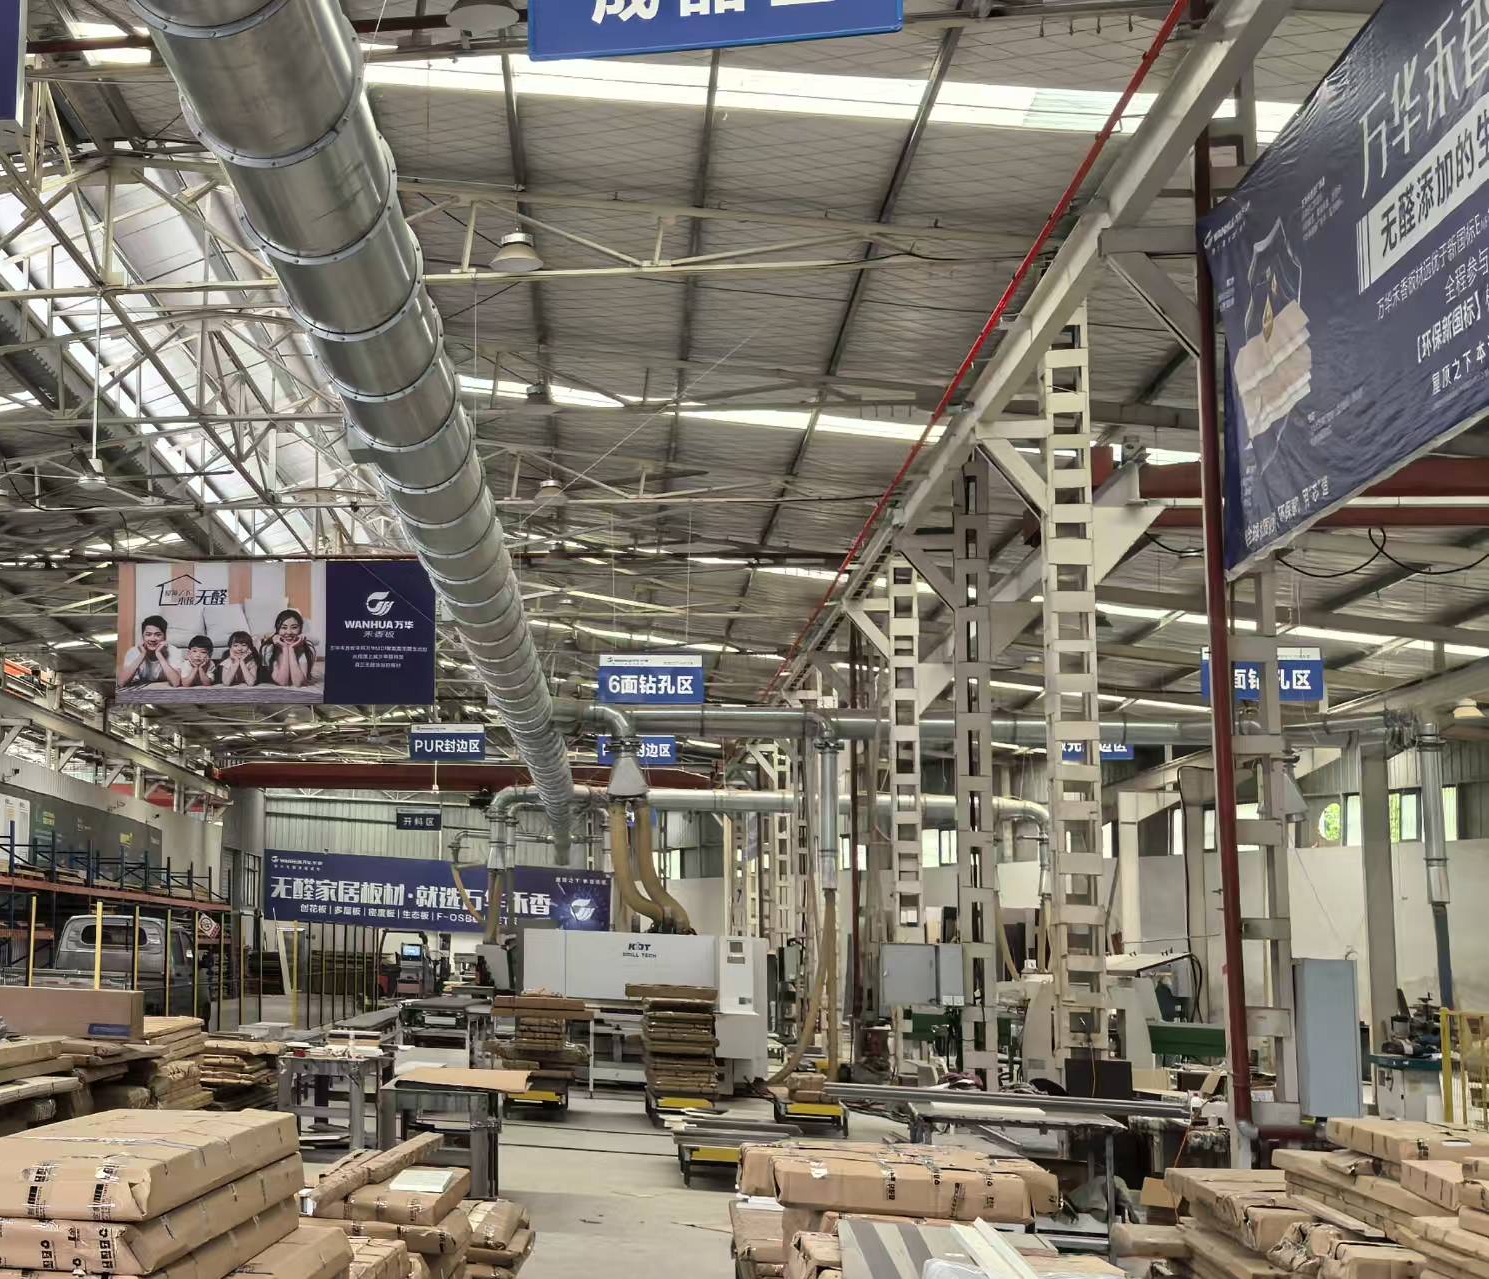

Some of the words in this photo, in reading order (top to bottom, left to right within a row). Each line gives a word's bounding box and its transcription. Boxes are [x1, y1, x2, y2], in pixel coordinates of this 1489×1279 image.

[1417, 284, 1489, 363] 【环保新国标】
[344, 620, 393, 629] WANHUA
[608, 674, 694, 694] 6面钻孔区
[1234, 668, 1312, 690] 面钻孔区
[414, 739, 481, 754] PUR封边区
